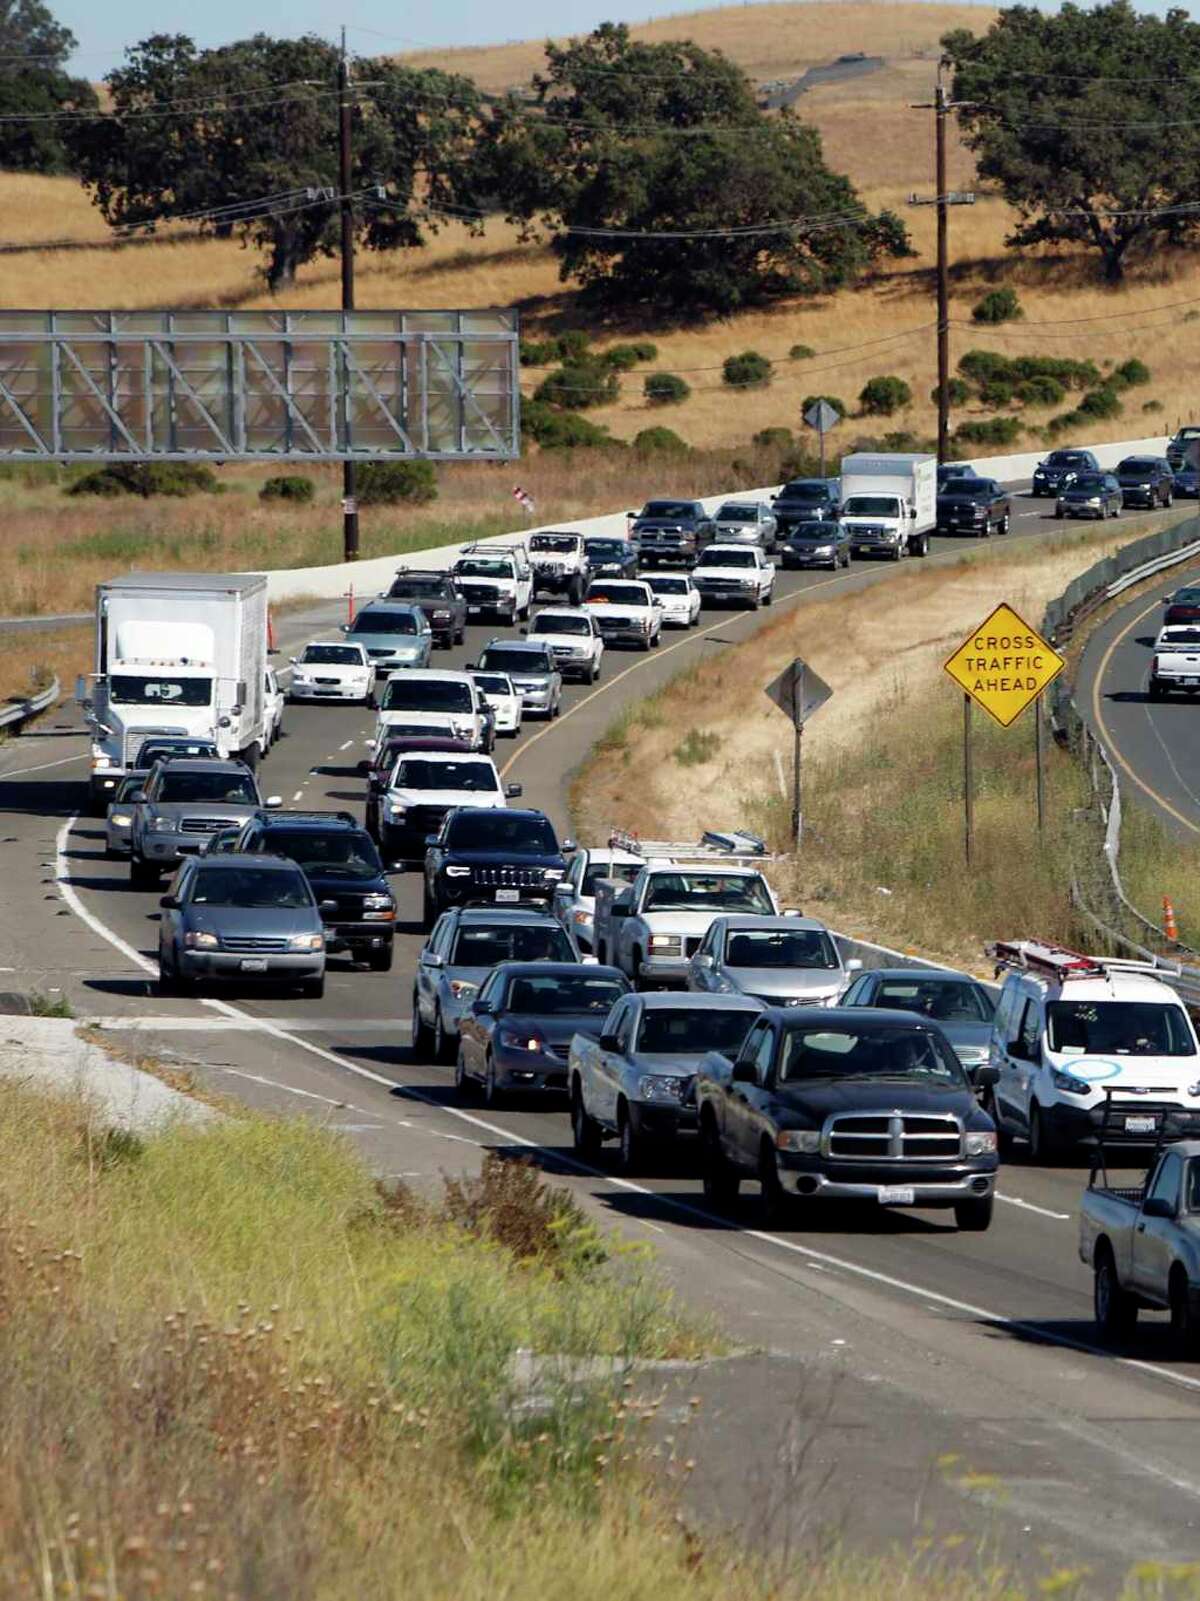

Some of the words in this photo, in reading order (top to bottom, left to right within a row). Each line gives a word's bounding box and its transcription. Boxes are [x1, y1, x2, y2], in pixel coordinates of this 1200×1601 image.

[974, 636, 1034, 650] CROSS
[965, 656, 1043, 672] TRAFFIC
[973, 677, 1038, 692] AHEAD
